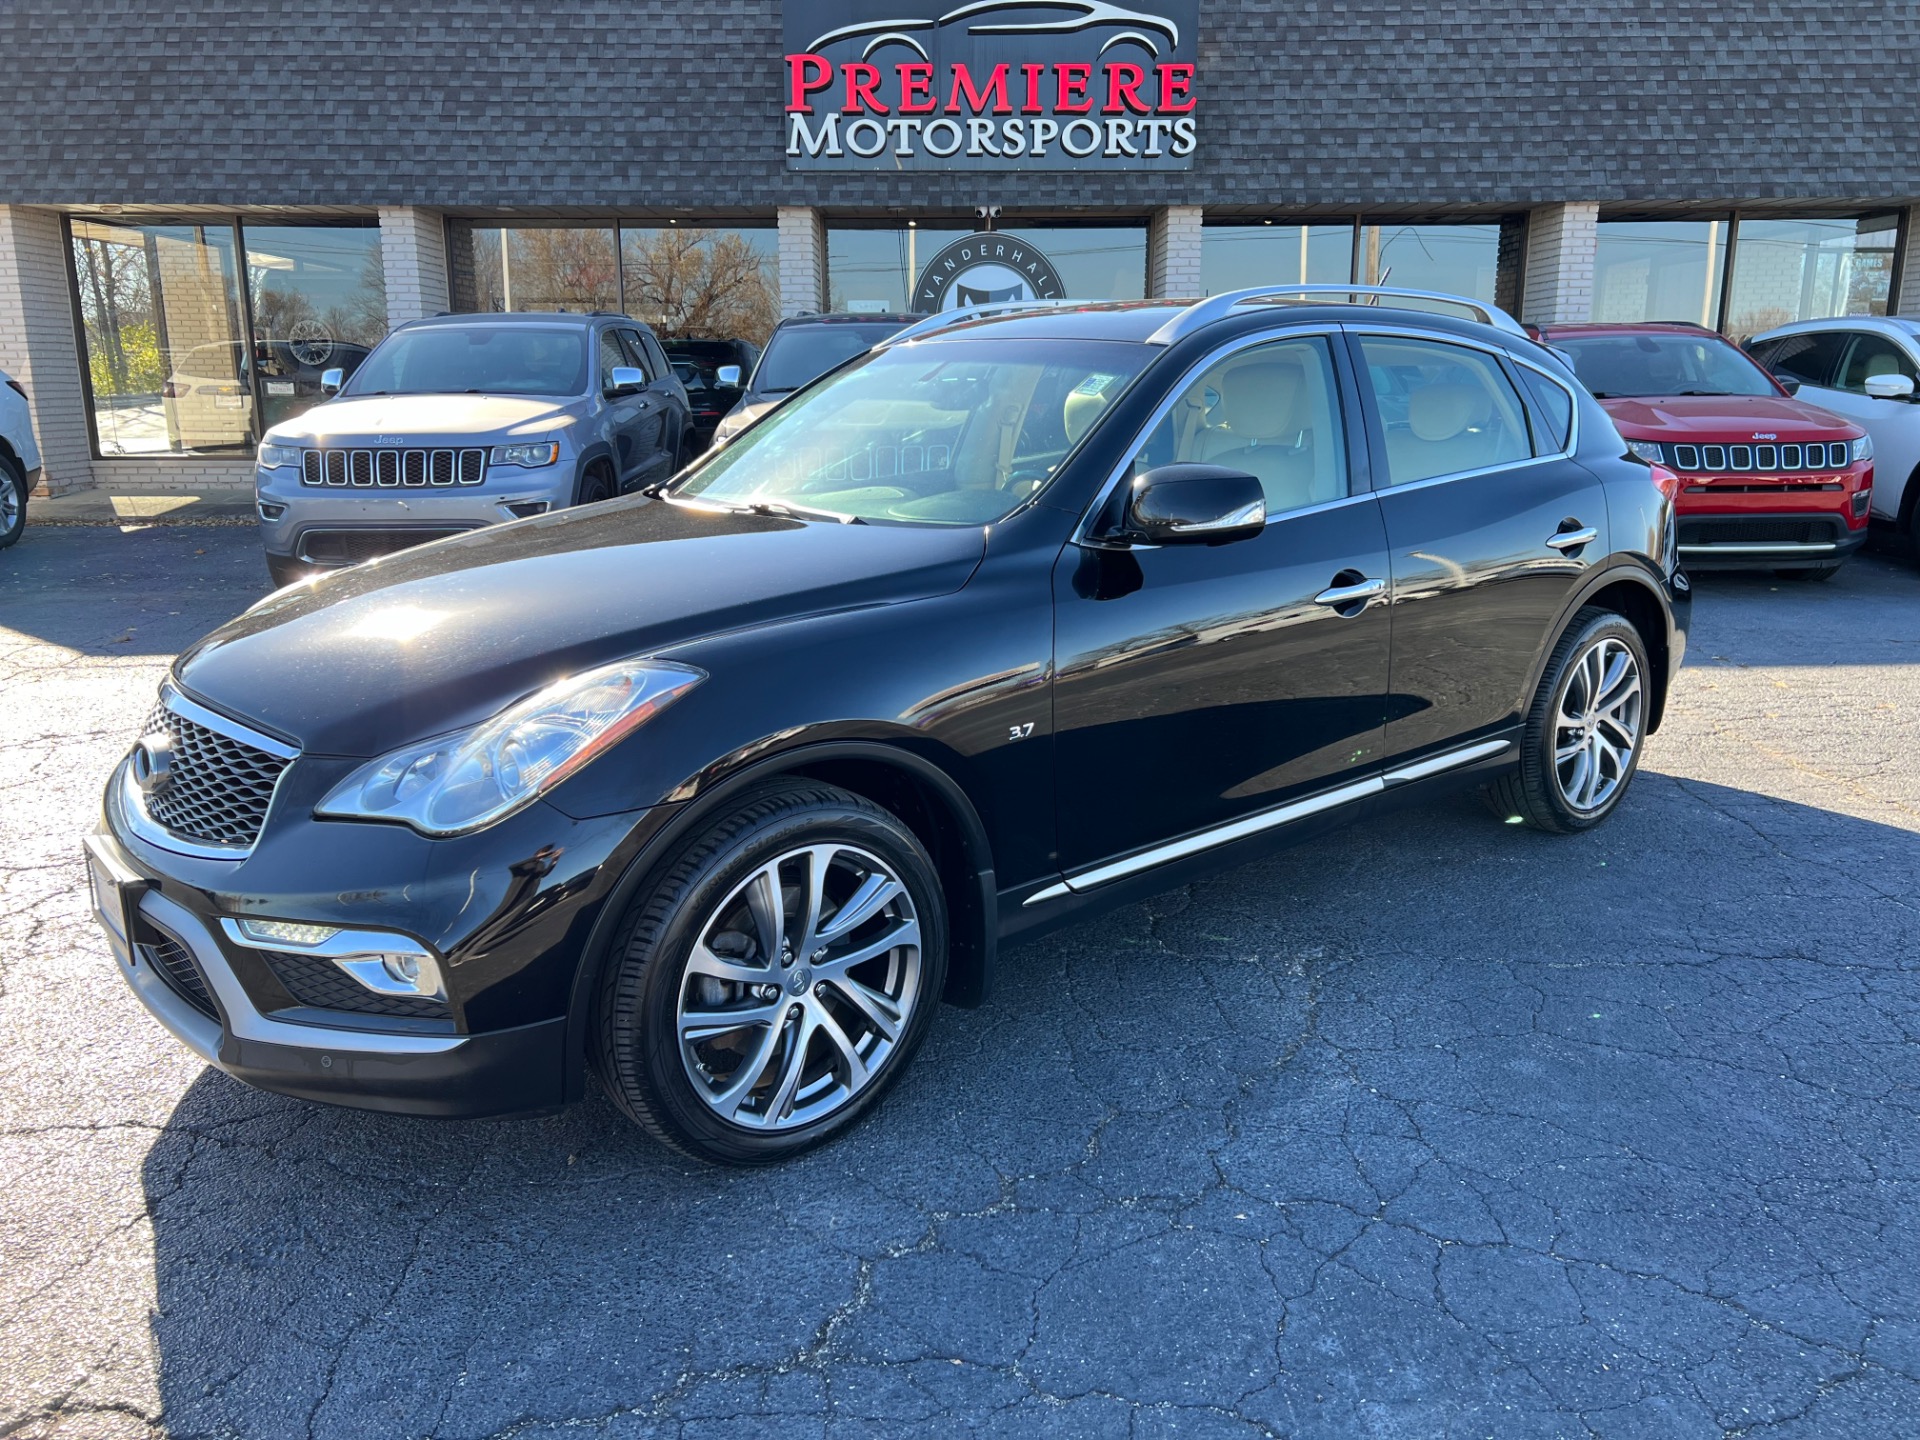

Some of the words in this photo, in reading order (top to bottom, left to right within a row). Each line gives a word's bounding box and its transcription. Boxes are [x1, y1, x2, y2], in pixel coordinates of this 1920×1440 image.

[785, 53, 1198, 115] PREMIERE
[786, 112, 1197, 157] MOTORSPORTS
[924, 244, 1055, 299] VANDERHALL
[374, 434, 404, 446] Jeep
[1752, 432, 1777, 441] Jeep
[1009, 722, 1035, 741] 3.7
